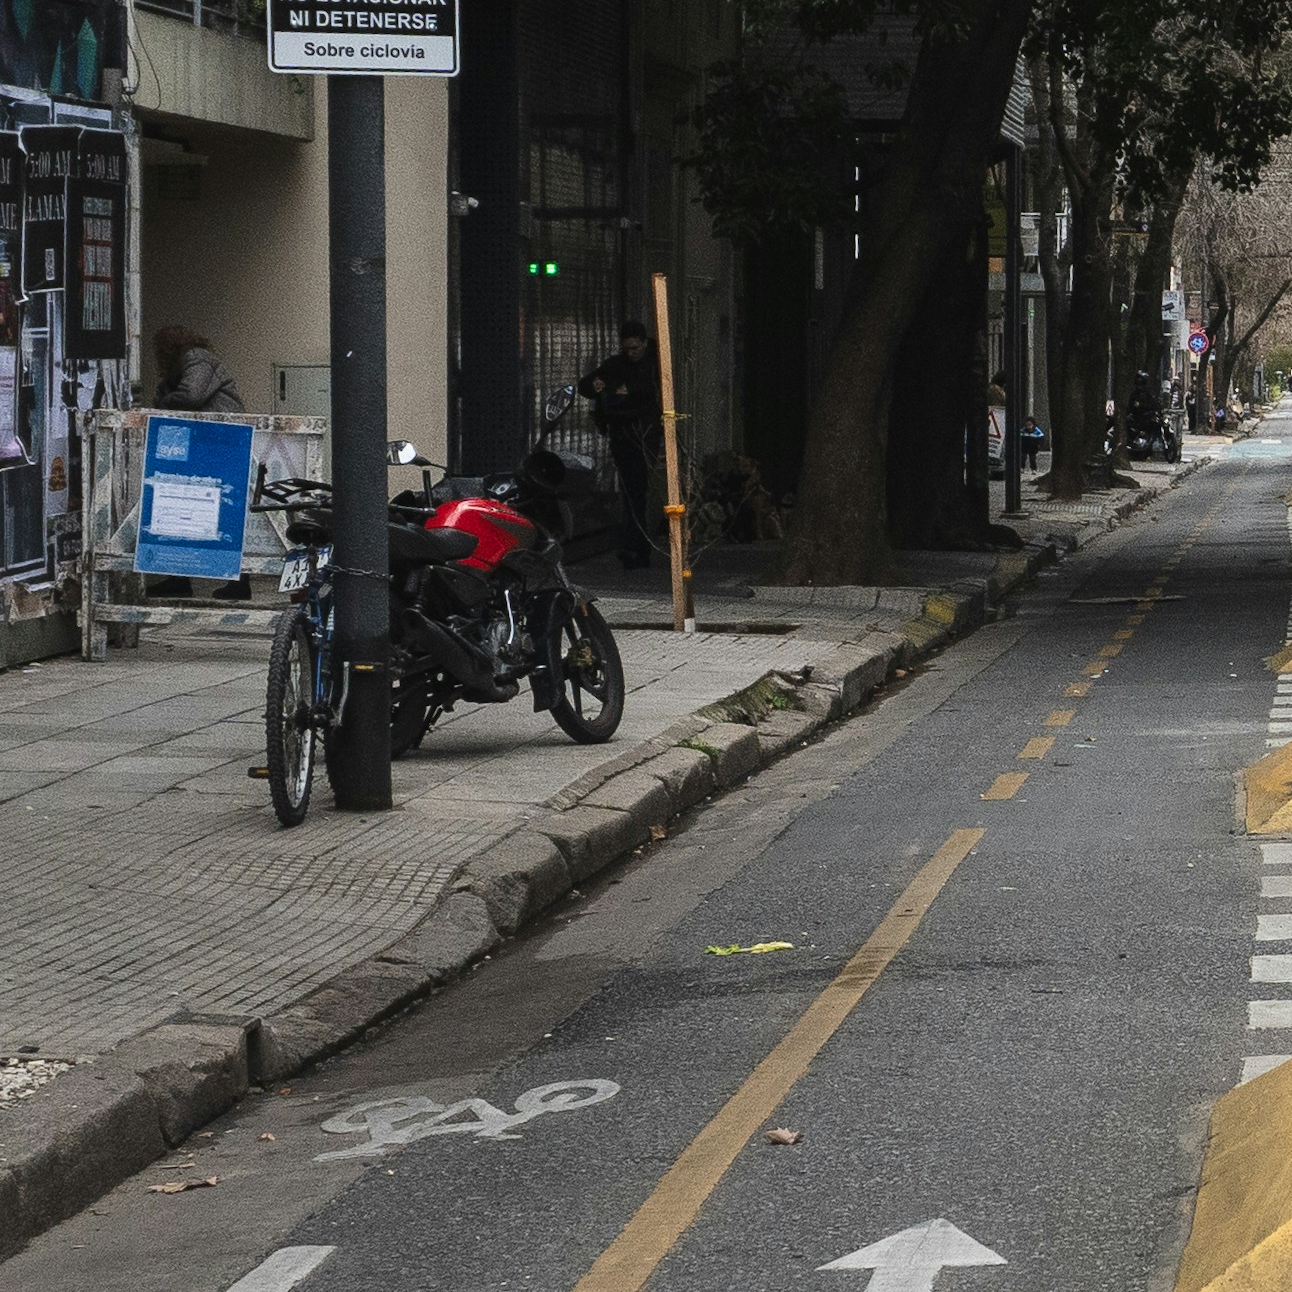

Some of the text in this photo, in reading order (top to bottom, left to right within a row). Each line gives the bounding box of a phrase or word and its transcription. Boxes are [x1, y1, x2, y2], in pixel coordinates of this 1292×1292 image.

[289, 10, 437, 30] NI DETENERSE
[304, 42, 425, 58] Sobre ciclovía
